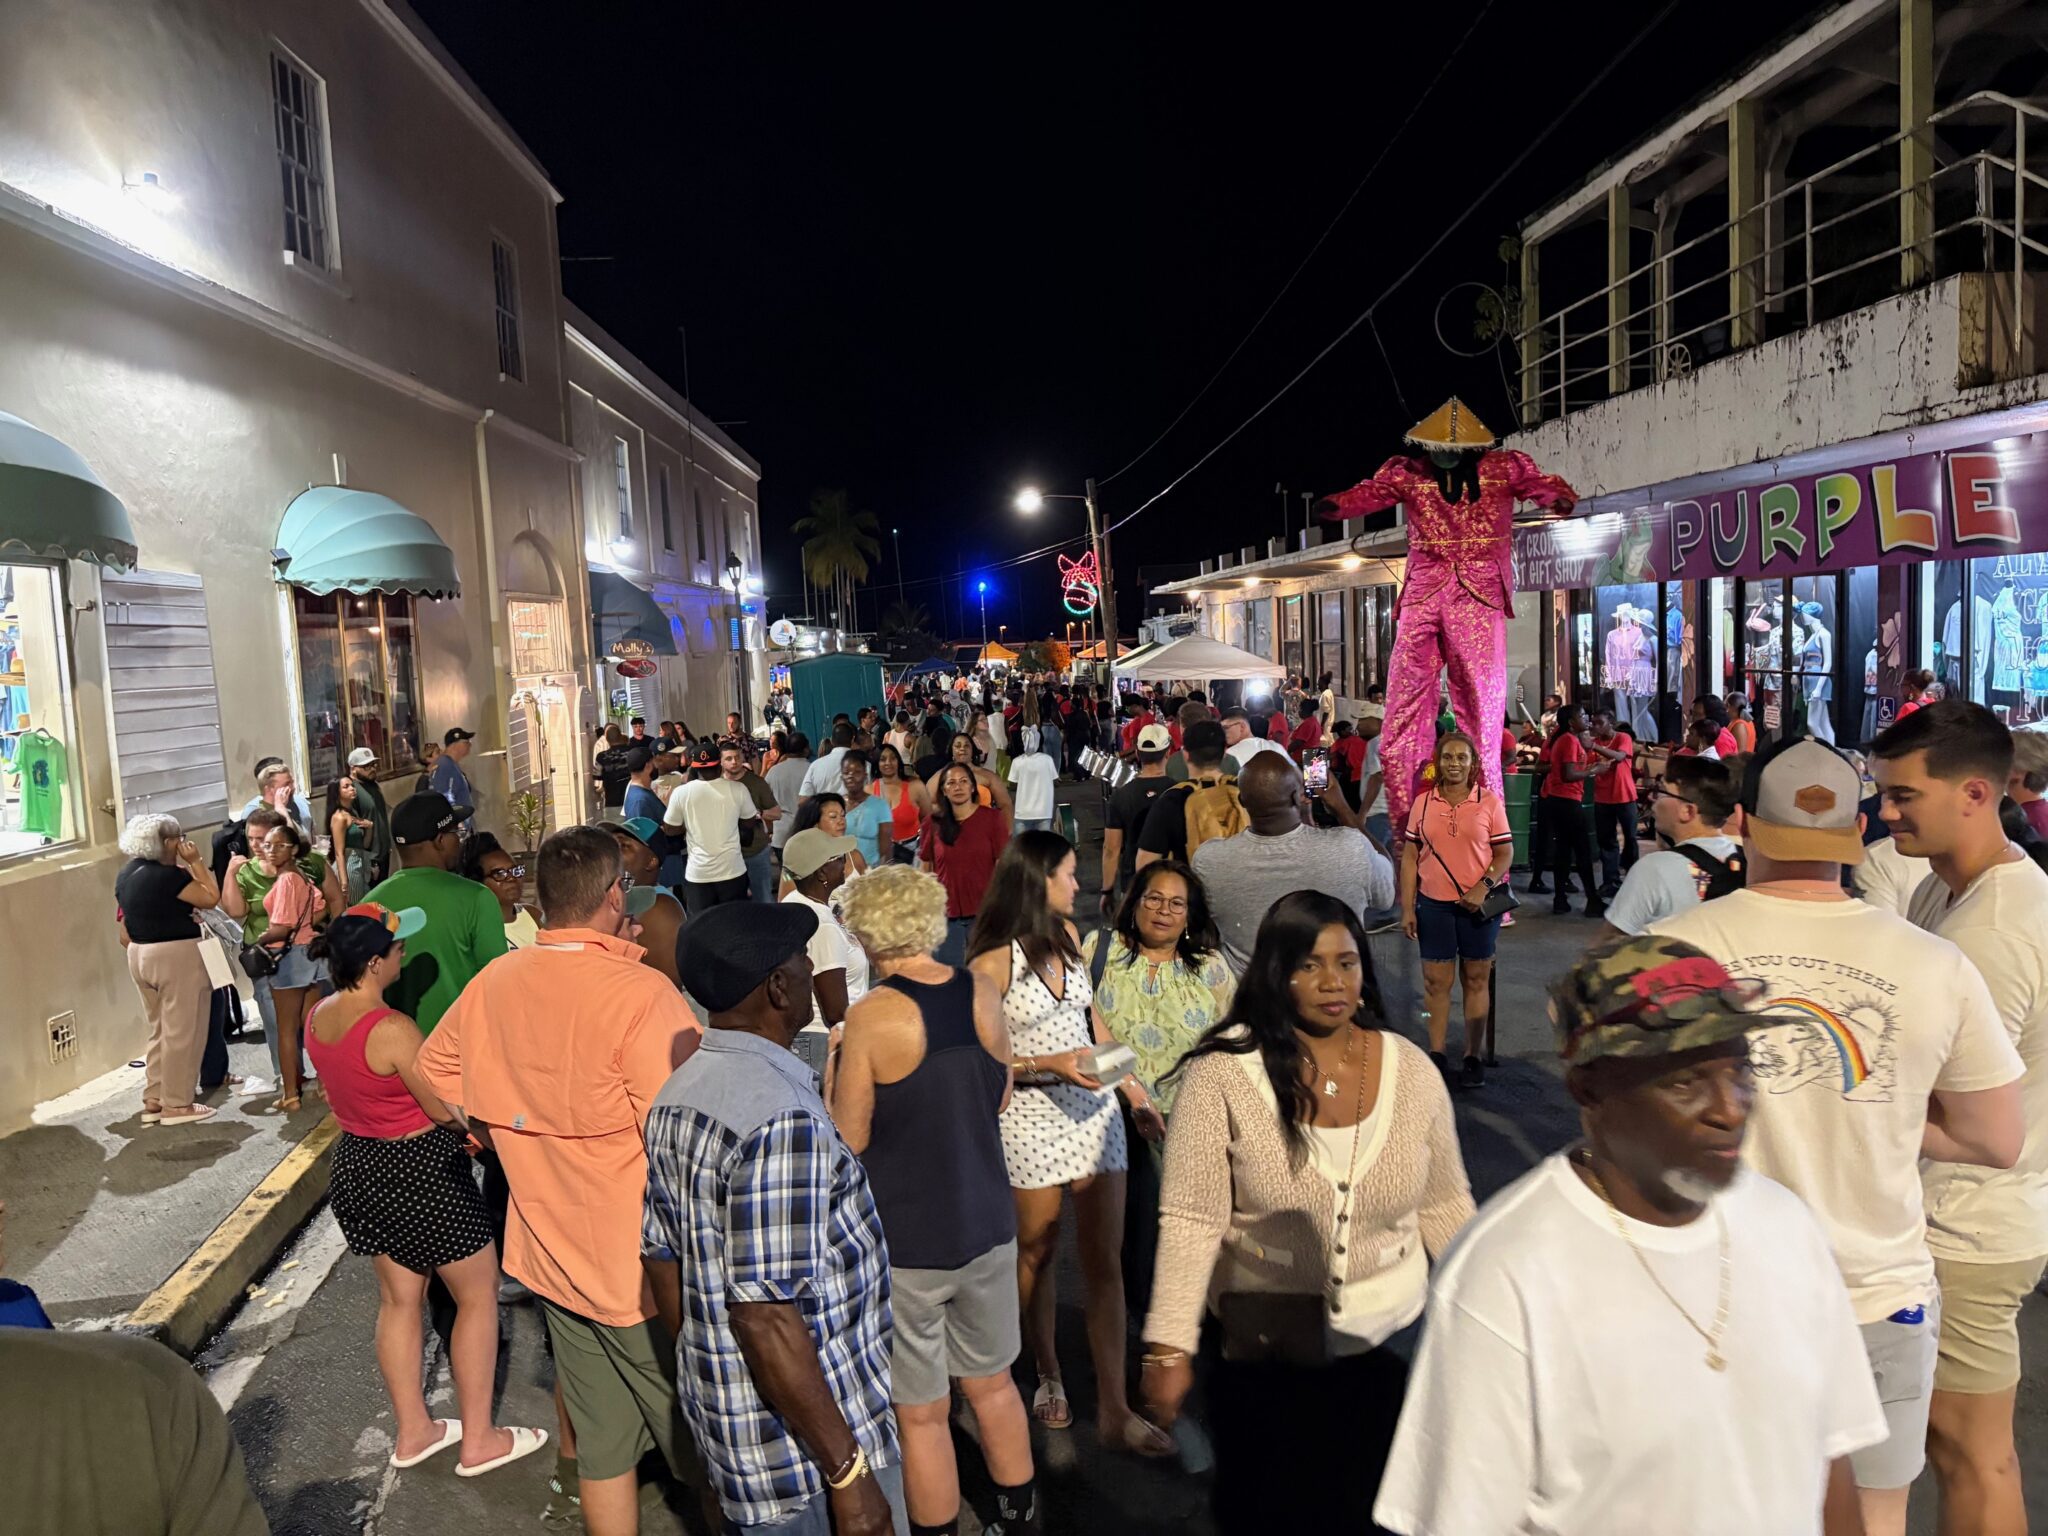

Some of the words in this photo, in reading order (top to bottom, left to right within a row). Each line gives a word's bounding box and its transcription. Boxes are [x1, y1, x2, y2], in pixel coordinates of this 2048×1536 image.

[1670, 451, 2022, 571] PURPLE
[1529, 559, 1552, 585] GIFT
[1555, 557, 1585, 584] SHOP
[612, 642, 651, 656] Molly's
[1744, 955, 1783, 968] YOU
[1788, 956, 1831, 971] OUT
[1833, 962, 1899, 996] THERE
